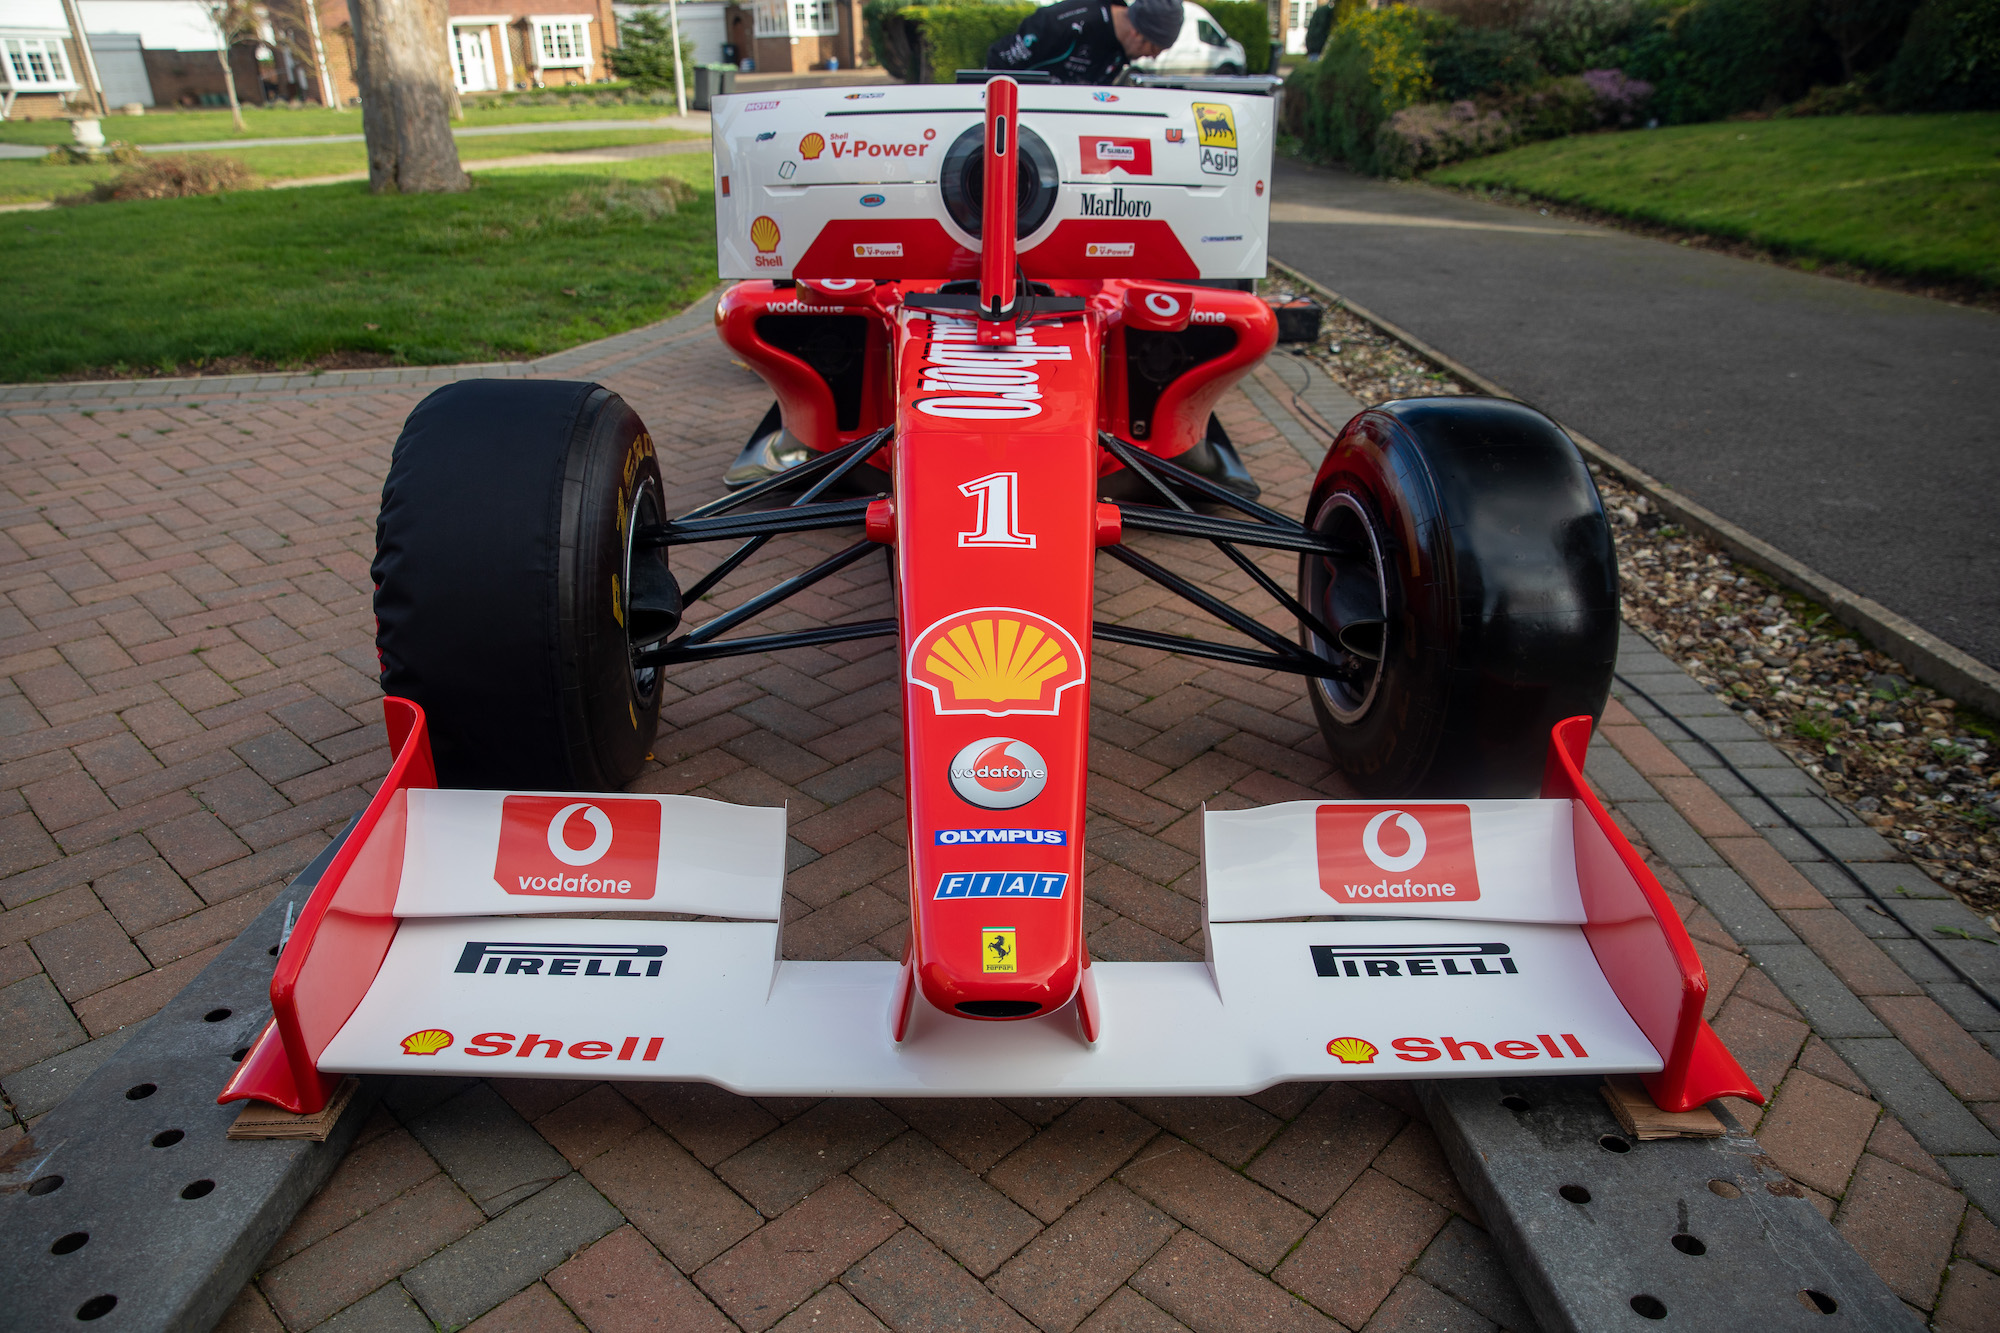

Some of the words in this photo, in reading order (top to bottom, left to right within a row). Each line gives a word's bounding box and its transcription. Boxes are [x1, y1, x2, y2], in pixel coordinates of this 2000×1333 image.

[745, 101, 780, 112] MOTUL
[831, 140, 929, 158] V-Power
[1202, 149, 1238, 172] Agip
[1080, 187, 1151, 217] Marlboro
[755, 255, 783, 267] Shell
[957, 472, 1037, 549] 1
[952, 765, 1046, 779] vodafone
[939, 830, 1063, 844] OLYMPUS
[518, 873, 632, 894] vodafone
[945, 877, 1060, 894] FIAT
[1343, 878, 1457, 899] vodafone
[453, 942, 668, 977] PIRELLI
[1309, 943, 1519, 977] PIRELLI
[464, 1032, 664, 1061] Shell
[1391, 1034, 1589, 1062] Shell
